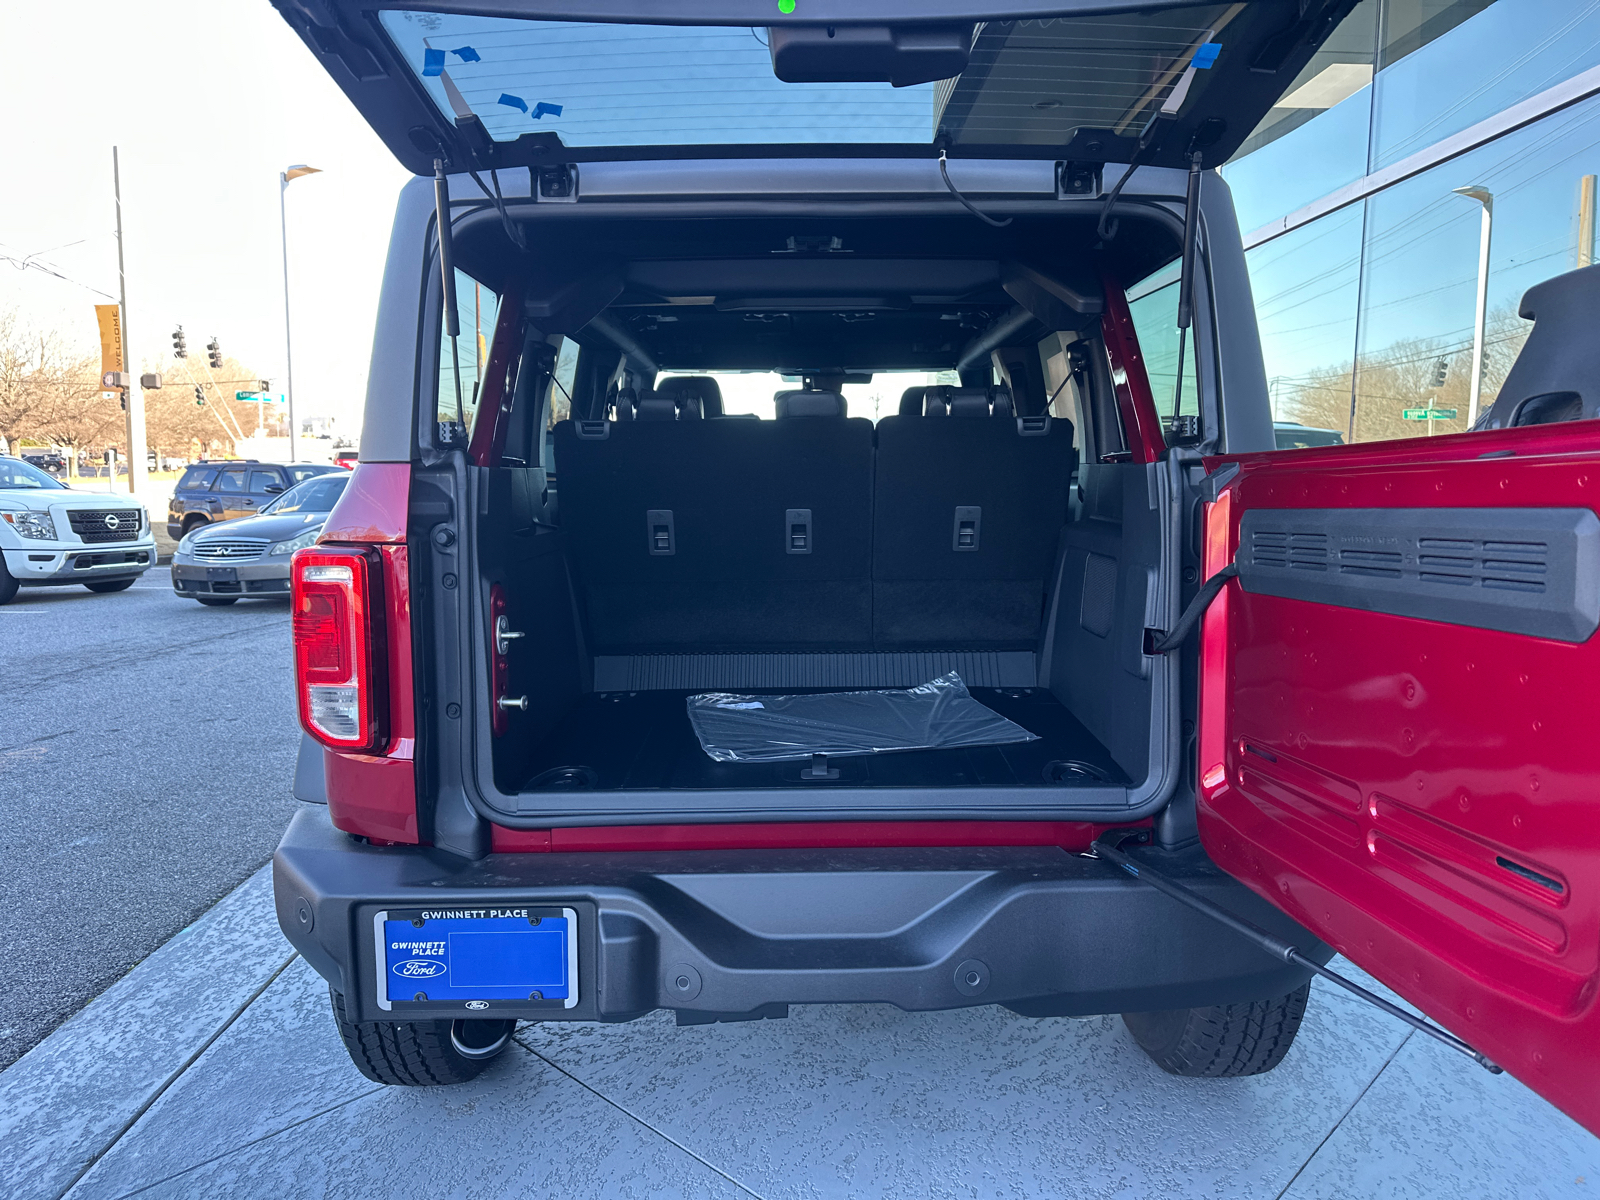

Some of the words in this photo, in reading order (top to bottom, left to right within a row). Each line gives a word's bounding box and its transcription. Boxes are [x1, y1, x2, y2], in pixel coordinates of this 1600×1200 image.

[112, 310, 121, 367] WELCOME
[422, 910, 486, 919] GWINNETT
[490, 910, 528, 918] PLACE
[403, 962, 436, 976] Ford
[469, 1001, 485, 1009] Ford
